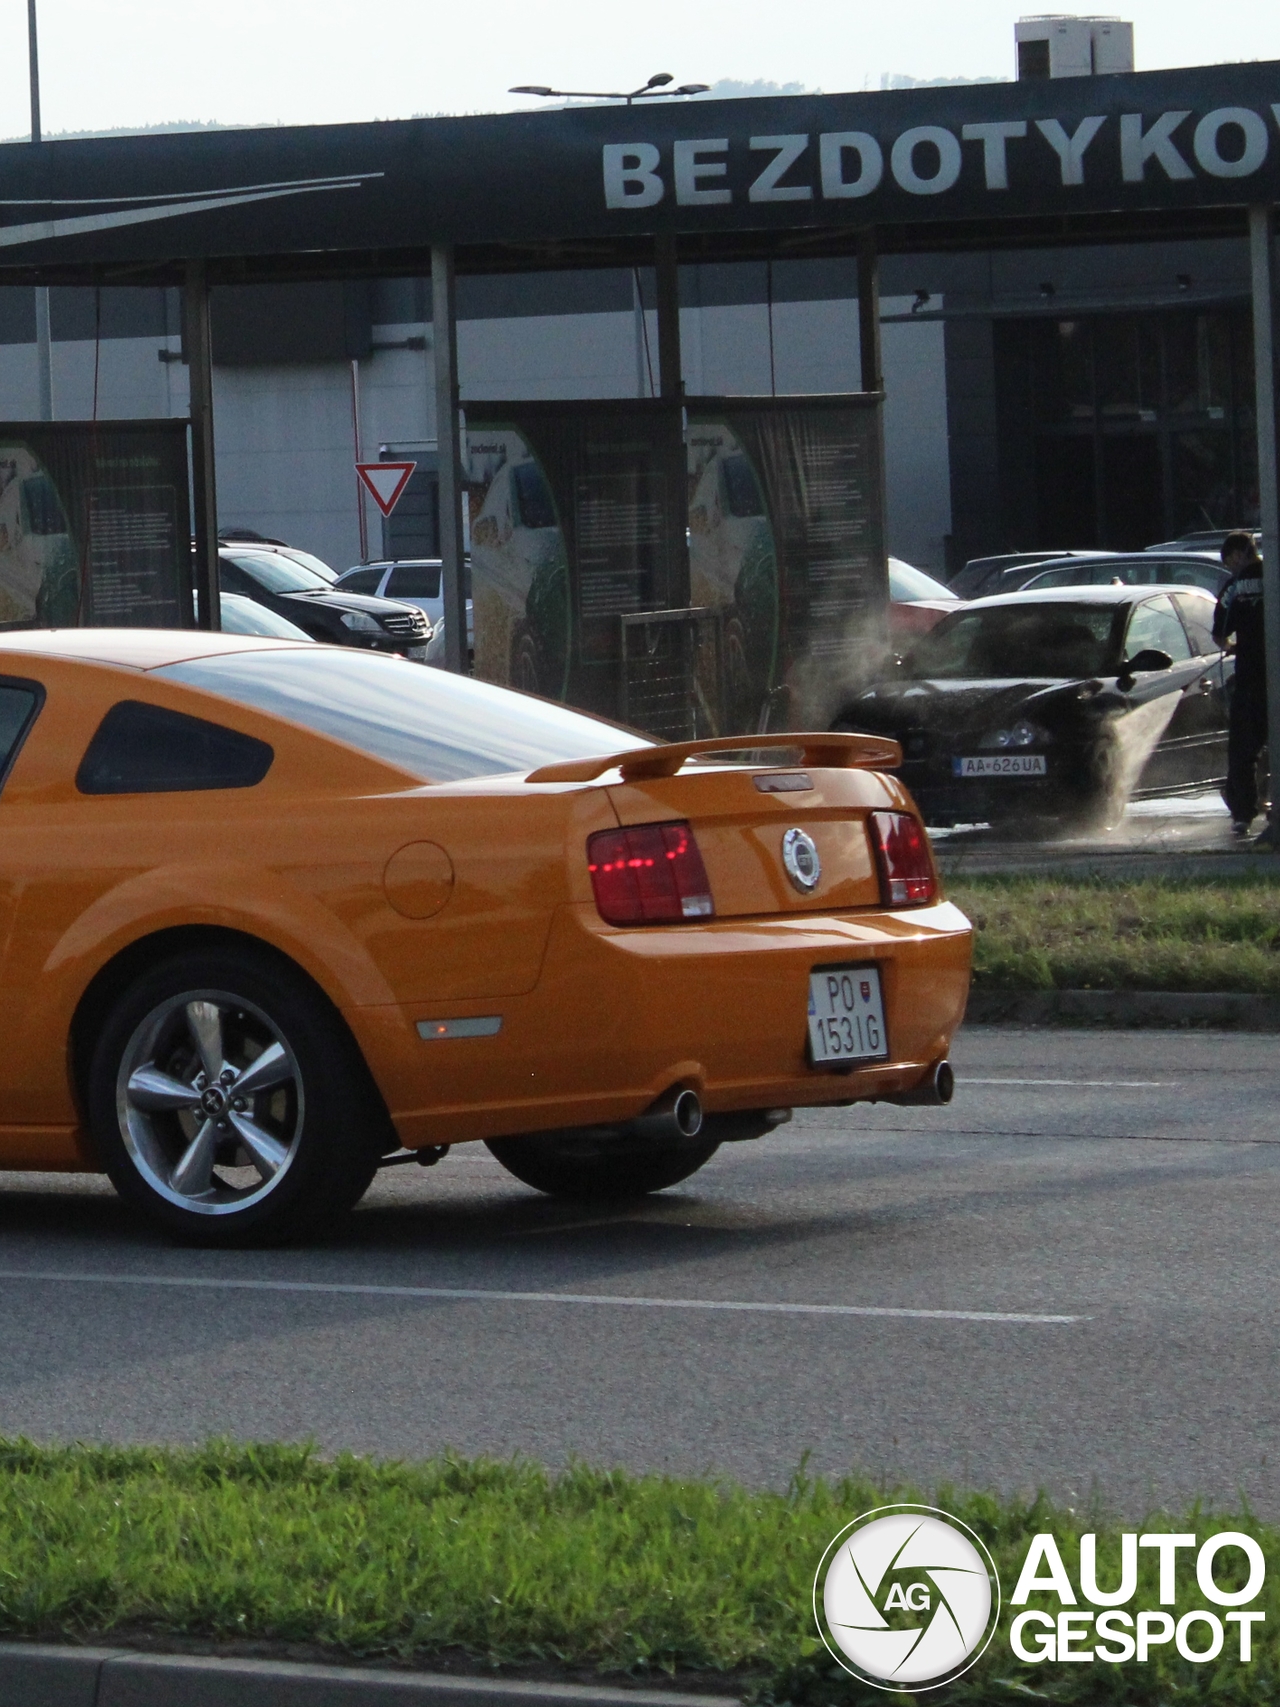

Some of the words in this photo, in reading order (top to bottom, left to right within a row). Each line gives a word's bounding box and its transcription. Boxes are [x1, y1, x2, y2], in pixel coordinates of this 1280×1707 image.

[602, 103, 1280, 209] BEZDOTYKO
[827, 975, 854, 1013] PO
[818, 1014, 879, 1055] 153IG
